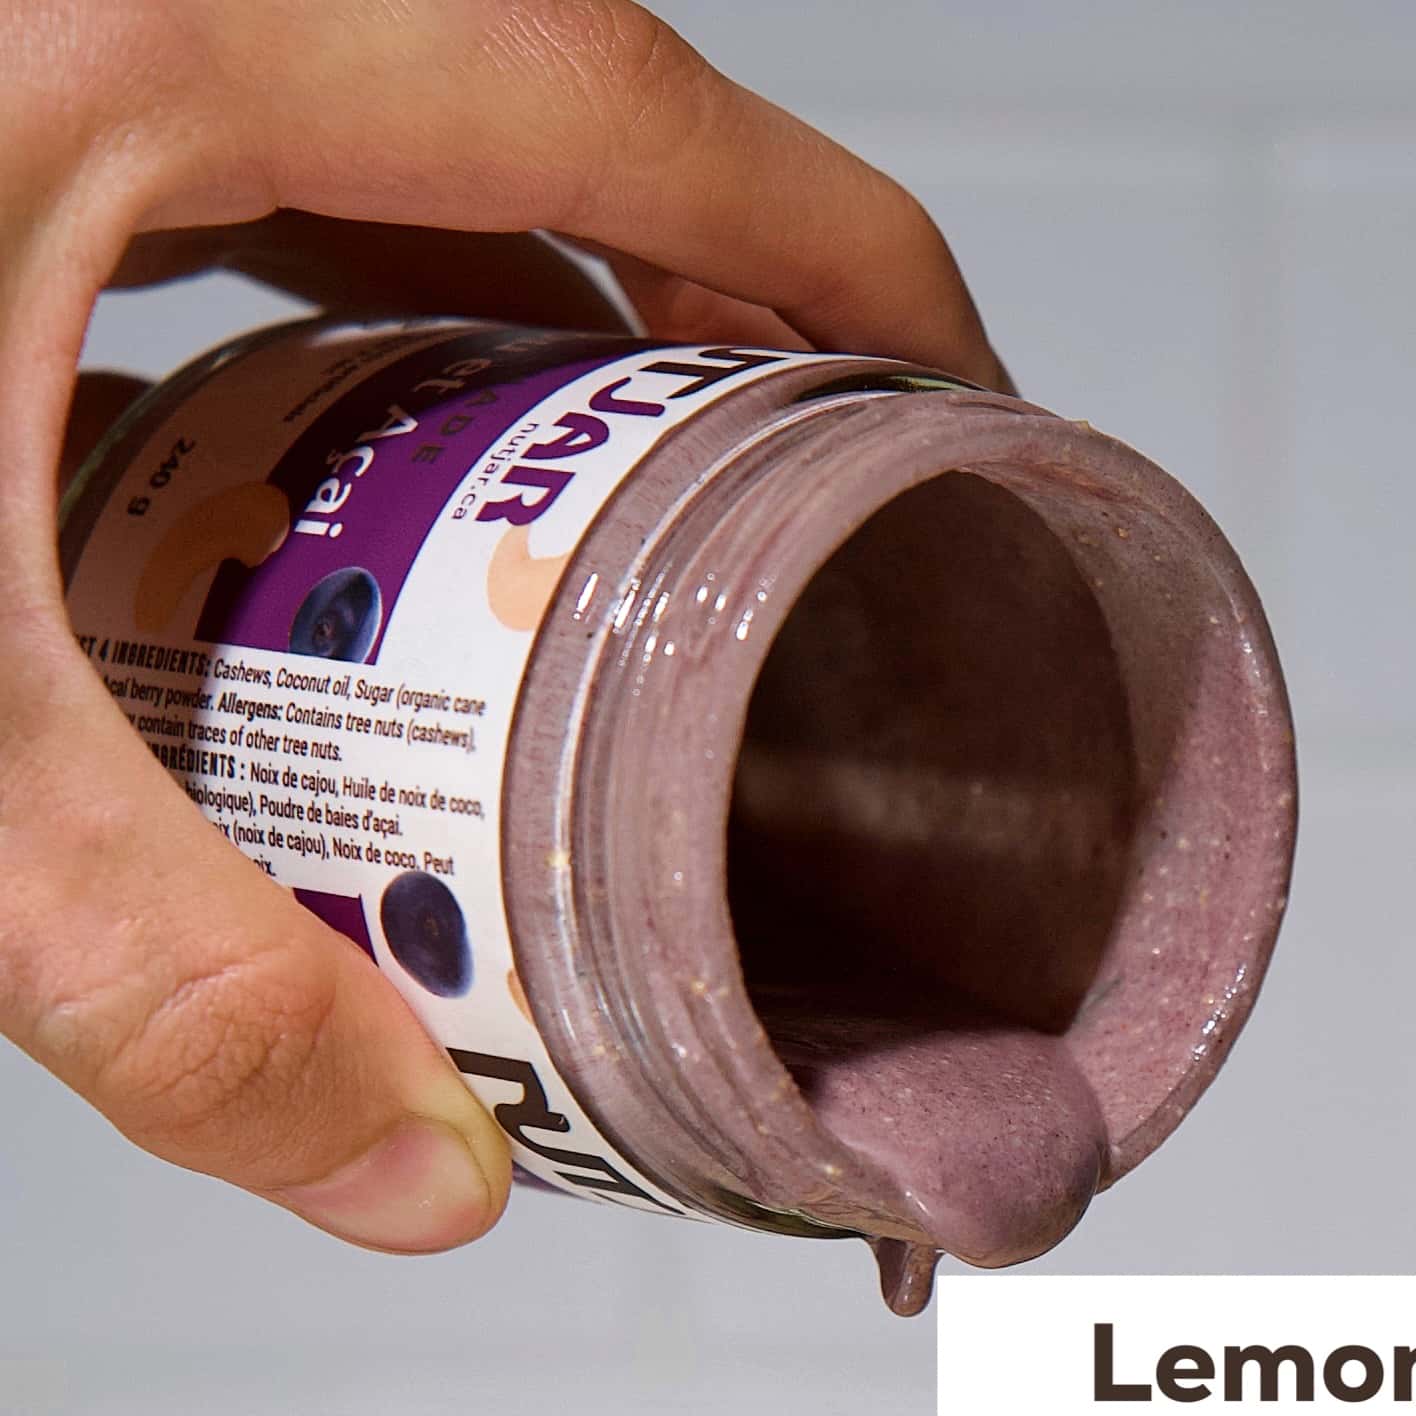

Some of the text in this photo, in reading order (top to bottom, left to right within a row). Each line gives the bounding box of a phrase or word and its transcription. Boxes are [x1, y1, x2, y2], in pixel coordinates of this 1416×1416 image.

[452, 422, 539, 520] nutjar.ca
[112, 639, 211, 677] INGREDIENTS:
[214, 658, 271, 689] Cashews,
[276, 667, 330, 695] Coconut
[332, 675, 351, 700] oil,
[354, 679, 394, 707] Sugar
[396, 683, 450, 713] (organic
[453, 695, 486, 716] cane
[131, 678, 163, 707] berry
[165, 688, 214, 710] powder.
[218, 692, 283, 721] Allergens:
[286, 702, 342, 729] Contains
[345, 711, 371, 734] tree
[374, 719, 403, 740] nuts
[138, 713, 184, 737] contain
[188, 719, 226, 743] traces
[229, 725, 244, 746] of
[246, 726, 280, 752] other
[283, 735, 308, 757] tree
[310, 741, 342, 762] nuts.
[250, 762, 279, 785] Noix
[282, 766, 298, 788] de
[301, 770, 339, 798] cajou,
[342, 775, 376, 801] Huile
[379, 781, 395, 803] de
[399, 786, 426, 808] noix
[430, 788, 447, 811] de
[449, 797, 485, 821] coco,
[260, 794, 304, 821] Poudre
[306, 800, 322, 824] de
[325, 803, 359, 830] baies
[233, 819, 265, 846] (noix
[268, 826, 284, 848] de
[286, 831, 329, 860] cajou),
[333, 837, 362, 861] Noix
[365, 841, 381, 864] de
[424, 851, 455, 875] Peut
